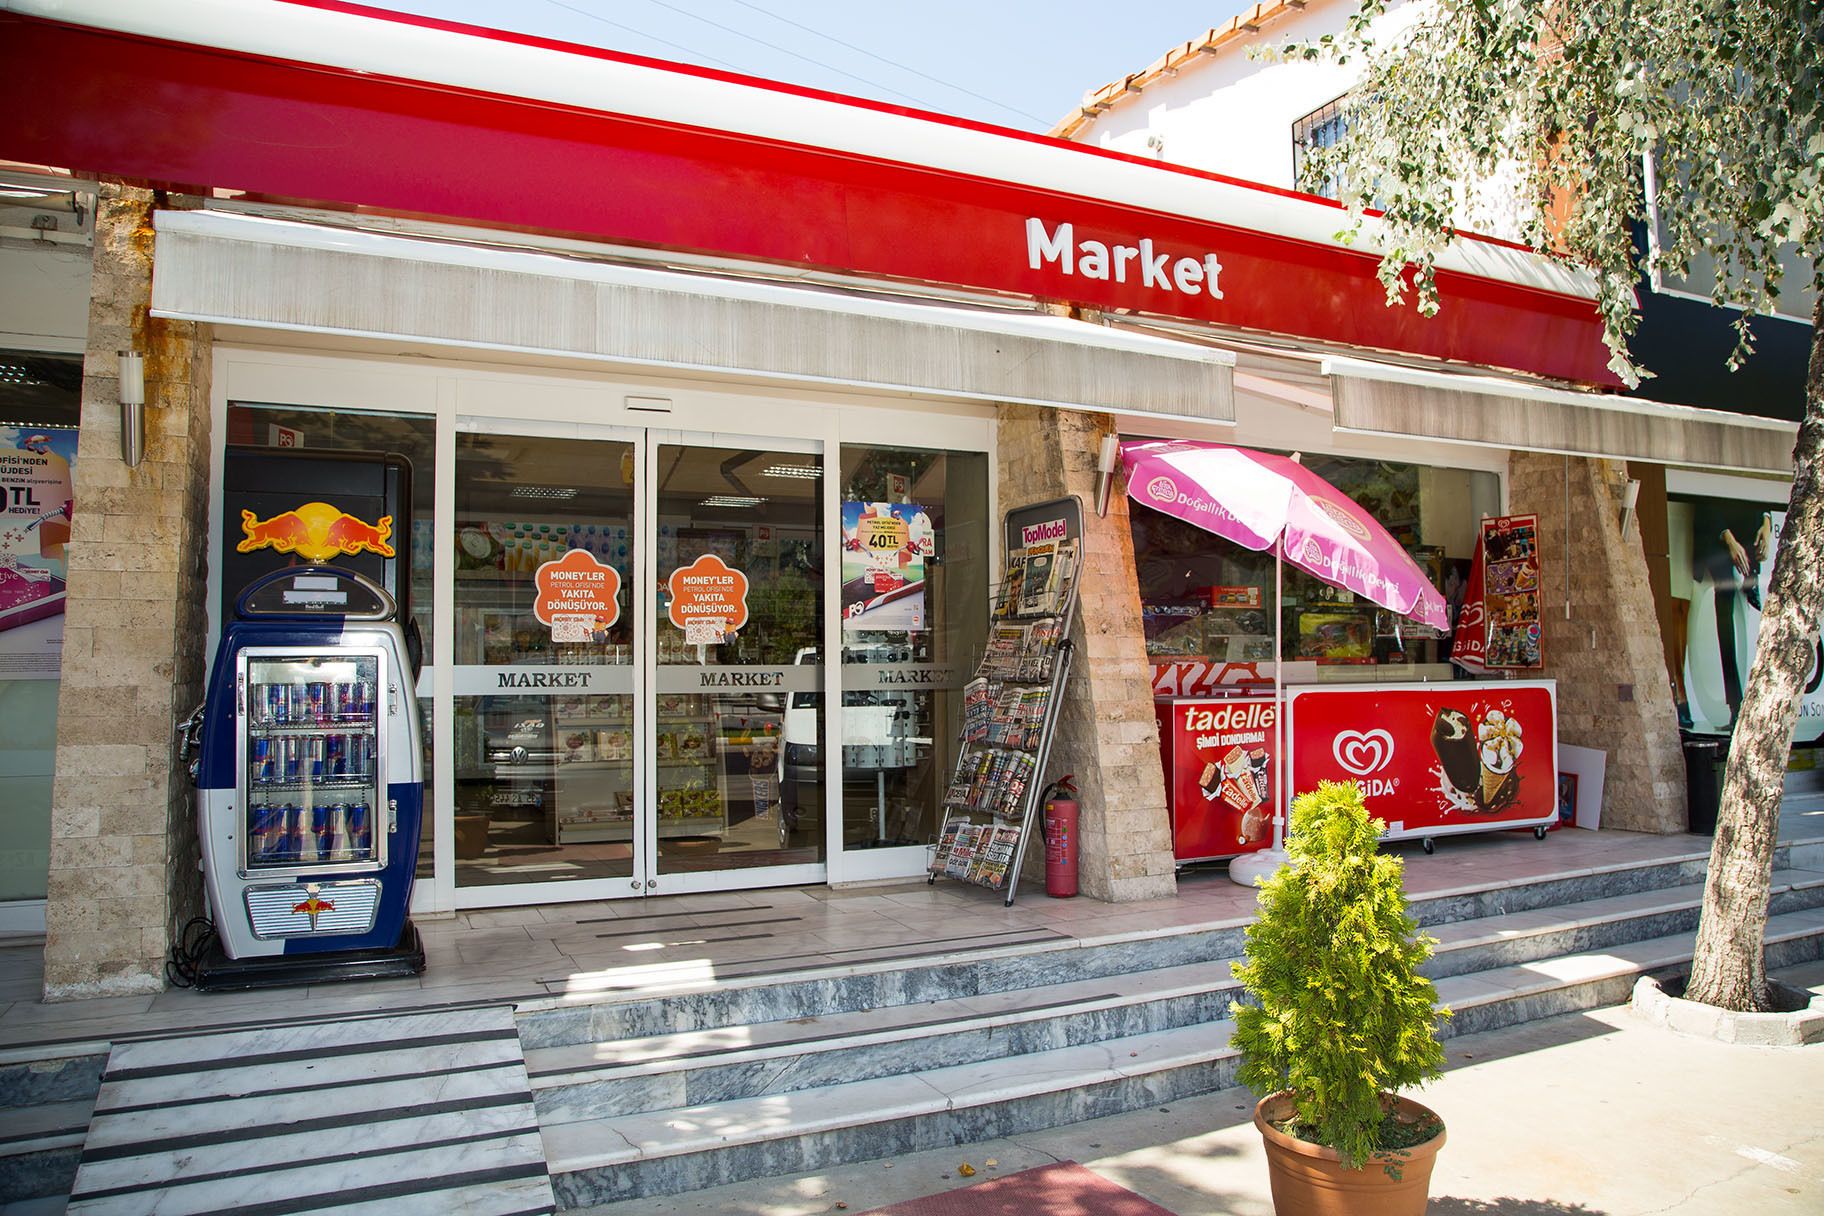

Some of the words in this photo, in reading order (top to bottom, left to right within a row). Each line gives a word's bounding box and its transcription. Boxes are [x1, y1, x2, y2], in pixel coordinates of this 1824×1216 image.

[1026, 217, 1224, 300] Market
[0, 455, 48, 466] FİSİ'NDEN
[1177, 492, 1227, 521] Doğallık
[1023, 519, 1066, 545] TopModel
[550, 571, 605, 581] MONEY'LER
[683, 576, 734, 585] MONEY'LER
[561, 589, 595, 598] YAKITA
[693, 593, 725, 602] YAKITA
[547, 599, 608, 612] DÖNÜŞÜYOR.
[681, 603, 737, 615] DÖNÜŞÜYOR.
[498, 672, 592, 688] MARKET
[700, 672, 784, 687] MARKET
[878, 670, 954, 684] MARKET
[1185, 704, 1276, 731] tadelle
[1196, 732, 1220, 750] ŞİMDİ
[1220, 730, 1265, 747] DONDURMA!
